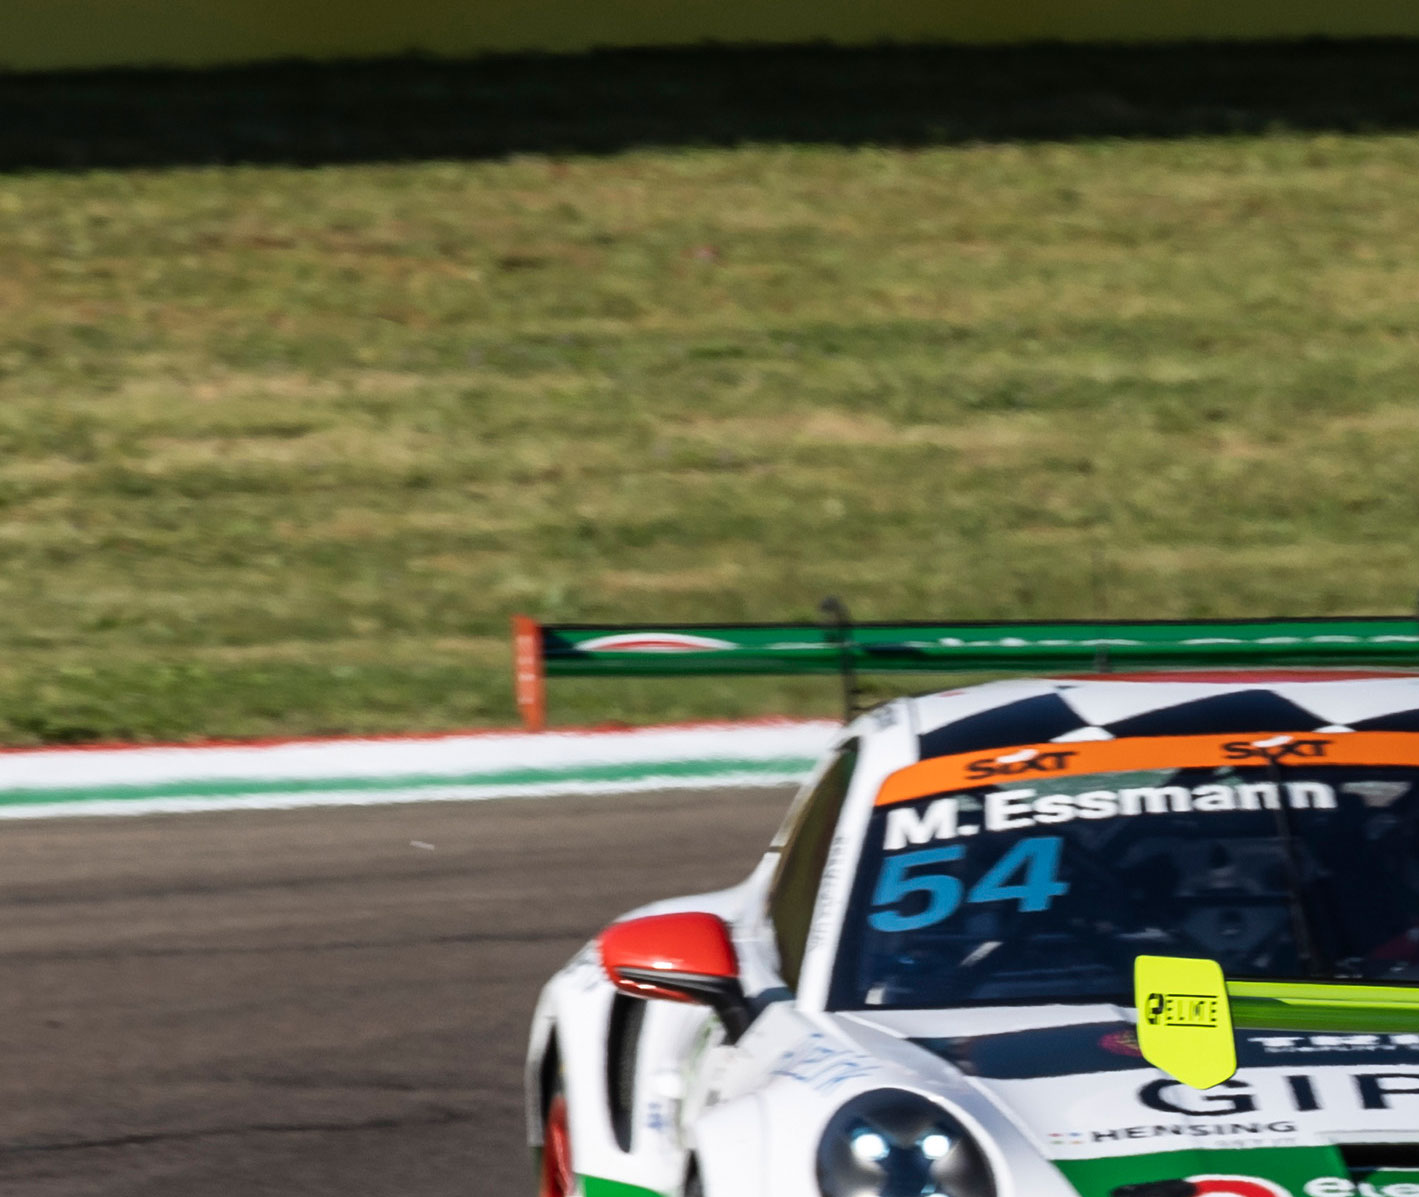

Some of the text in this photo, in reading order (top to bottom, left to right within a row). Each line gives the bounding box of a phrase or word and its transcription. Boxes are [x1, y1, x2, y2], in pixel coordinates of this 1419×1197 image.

[883, 778, 1337, 850] M. Essmann
[867, 836, 1070, 932] 54
[1091, 1121, 1297, 1143] HENSING
